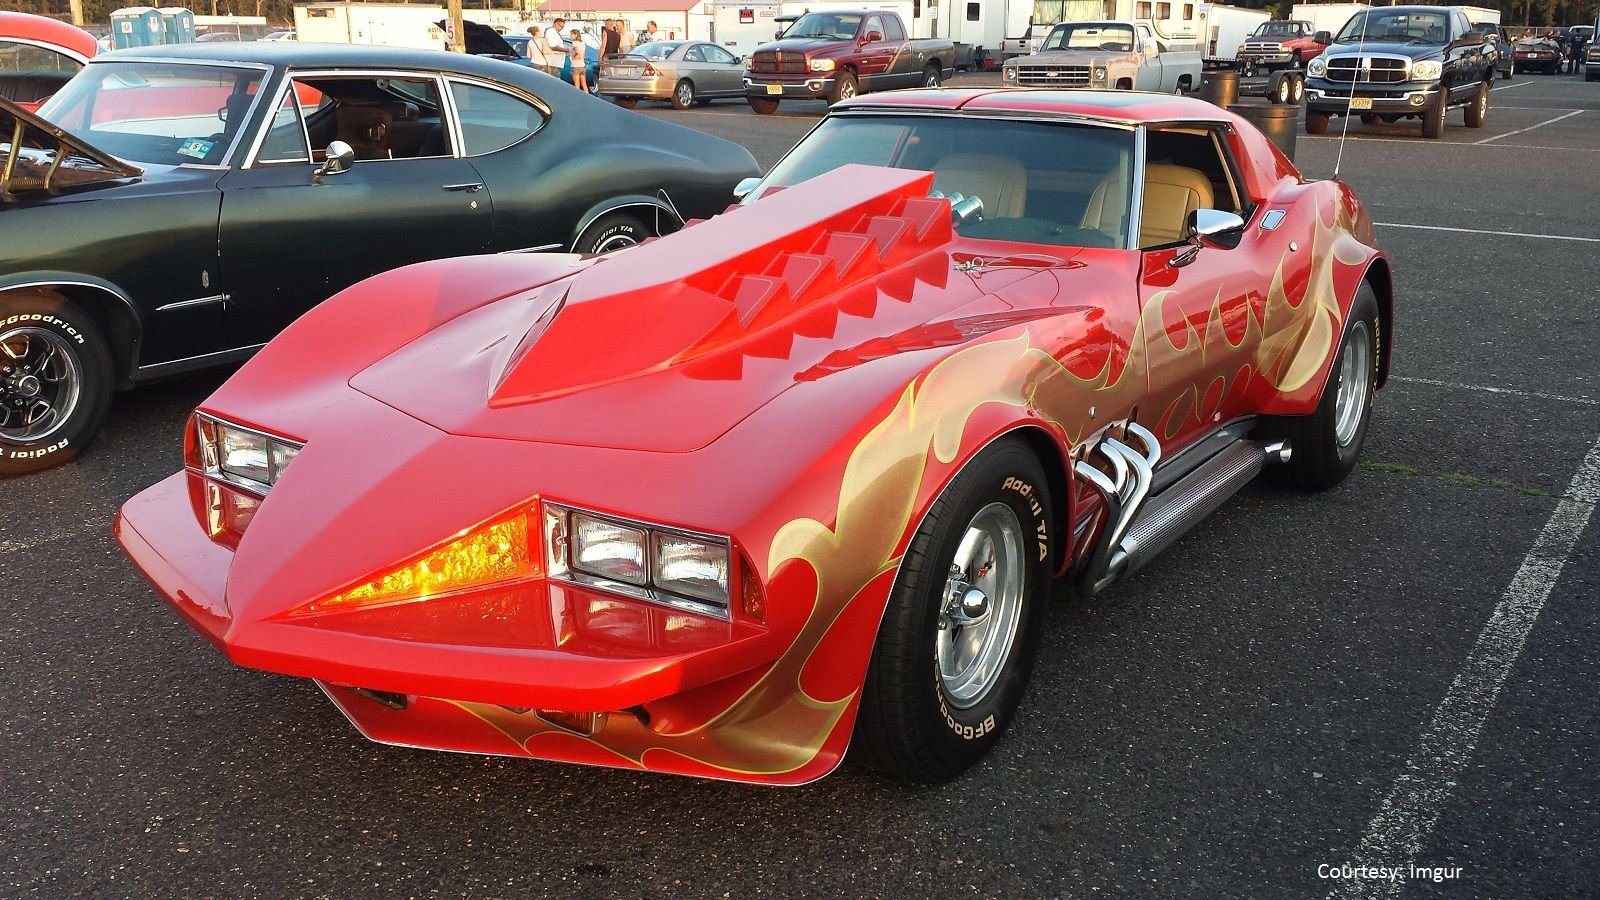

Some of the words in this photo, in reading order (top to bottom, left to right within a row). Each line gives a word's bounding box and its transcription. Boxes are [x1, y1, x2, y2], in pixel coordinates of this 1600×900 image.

[447, 25, 454, 40] 5
[591, 226, 618, 254] Radial
[620, 225, 633, 233] T/A
[10, 437, 69, 459] Radial
[1002, 476, 1042, 517] Radial
[1037, 519, 1048, 562] T/A
